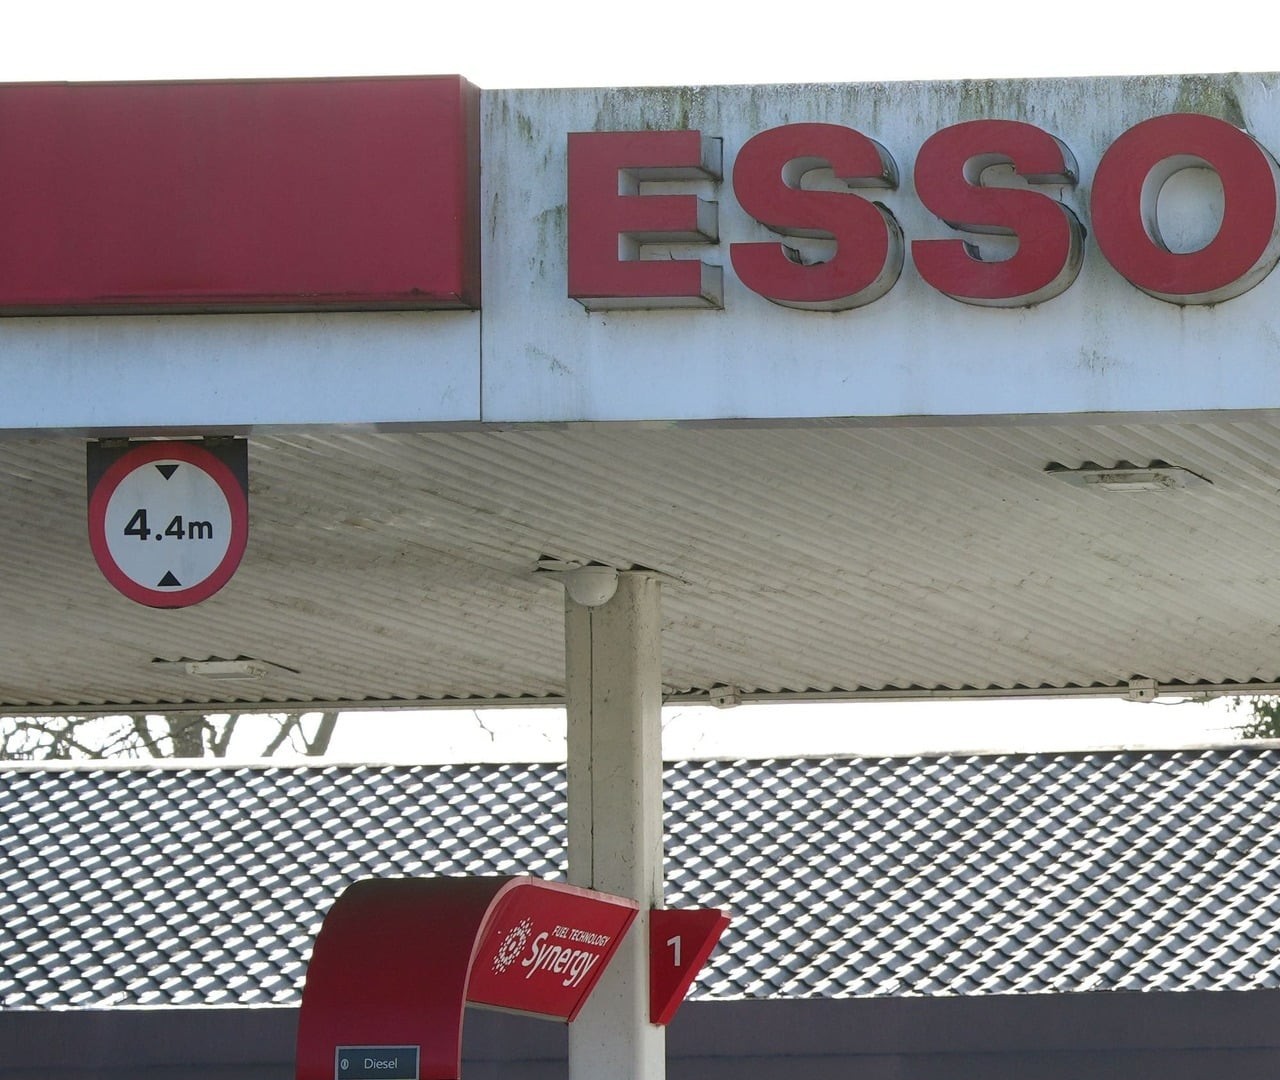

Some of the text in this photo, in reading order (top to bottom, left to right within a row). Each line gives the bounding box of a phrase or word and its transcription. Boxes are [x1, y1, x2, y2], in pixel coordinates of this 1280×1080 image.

[123, 508, 214, 541] 4.4m
[551, 925, 611, 947] FUEL TECHNOLOGY
[667, 935, 681, 967] 1
[521, 931, 600, 988] Synergy
[363, 1058, 398, 1069] Diesel
